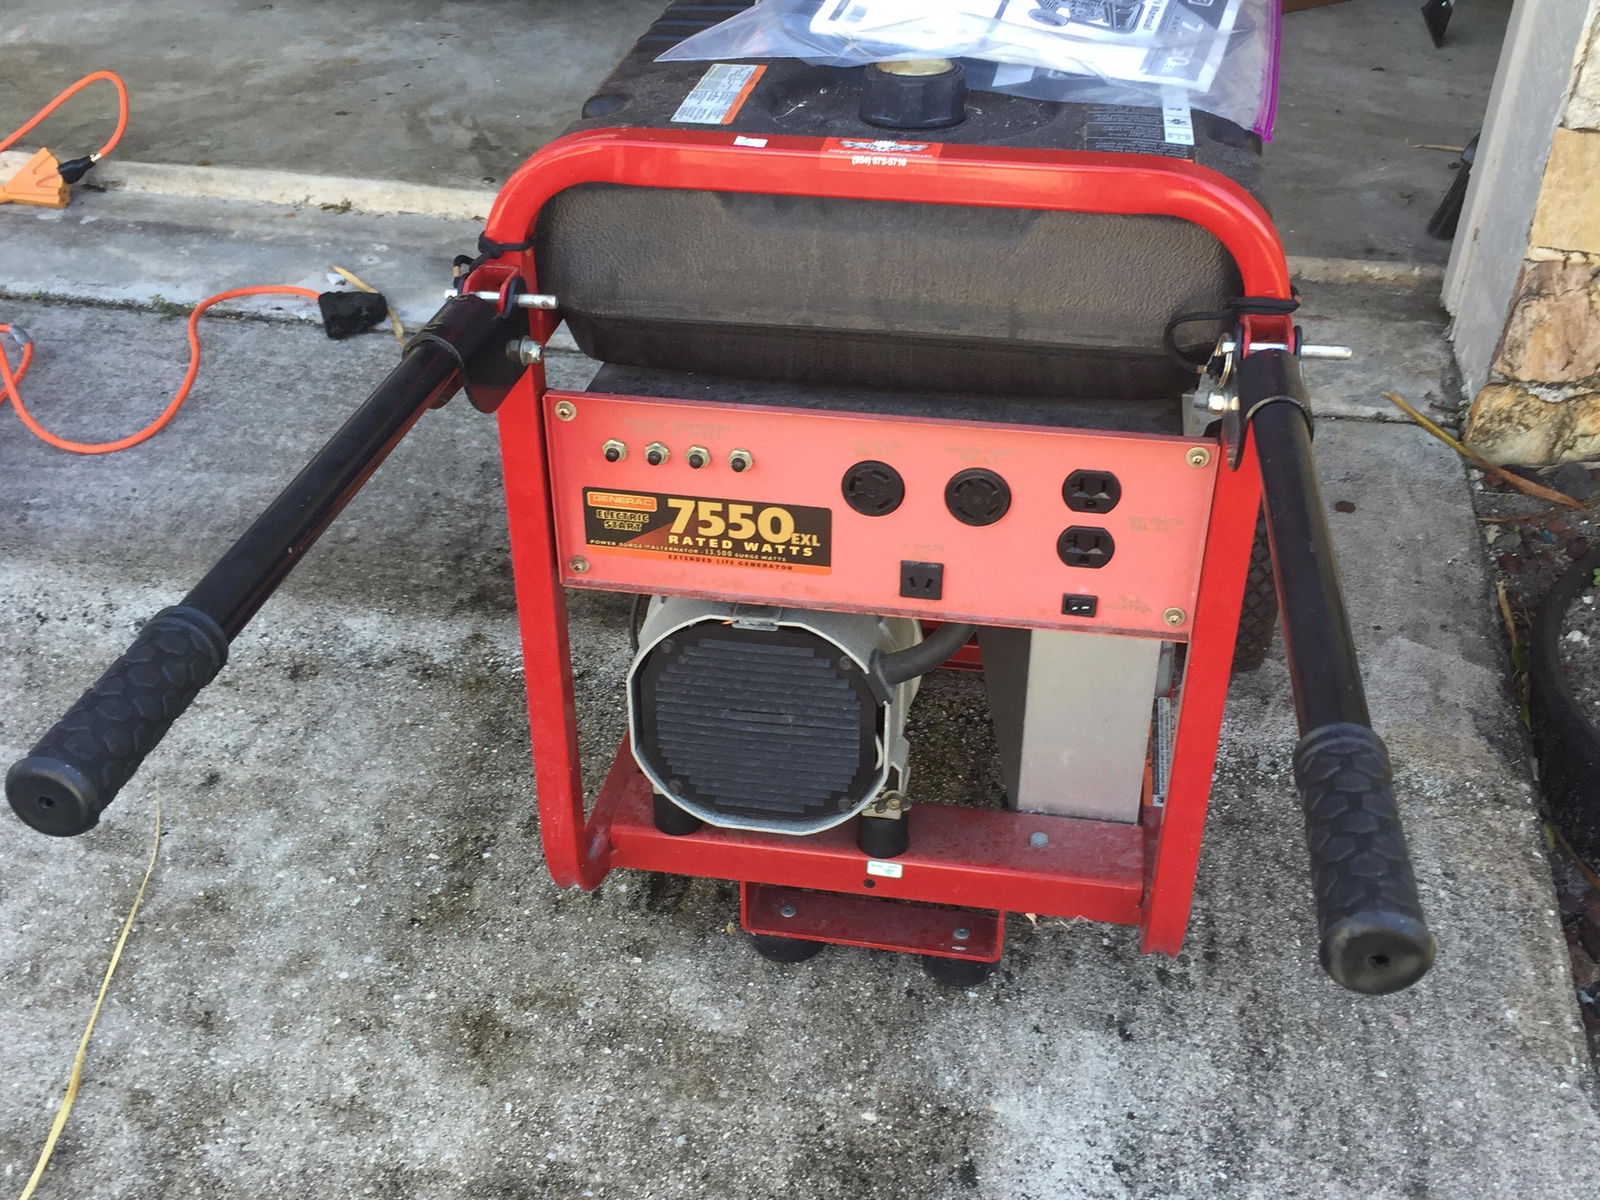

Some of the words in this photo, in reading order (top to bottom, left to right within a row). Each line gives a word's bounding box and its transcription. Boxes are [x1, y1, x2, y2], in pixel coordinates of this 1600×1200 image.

[592, 494, 653, 507] GENERAC
[596, 509, 650, 523] ELECTRIC
[667, 498, 795, 544] 7550
[791, 532, 821, 547] EXL
[604, 519, 643, 532] START
[650, 544, 699, 554] ALTERNATOR
[734, 552, 759, 560] SURGE
[760, 554, 787, 562] WATTS
[668, 535, 734, 550] RATED
[743, 541, 814, 557] WATTS
[668, 554, 713, 563] EXTENDED
[716, 558, 735, 566] LIFE
[738, 561, 794, 571] GENERATOR
